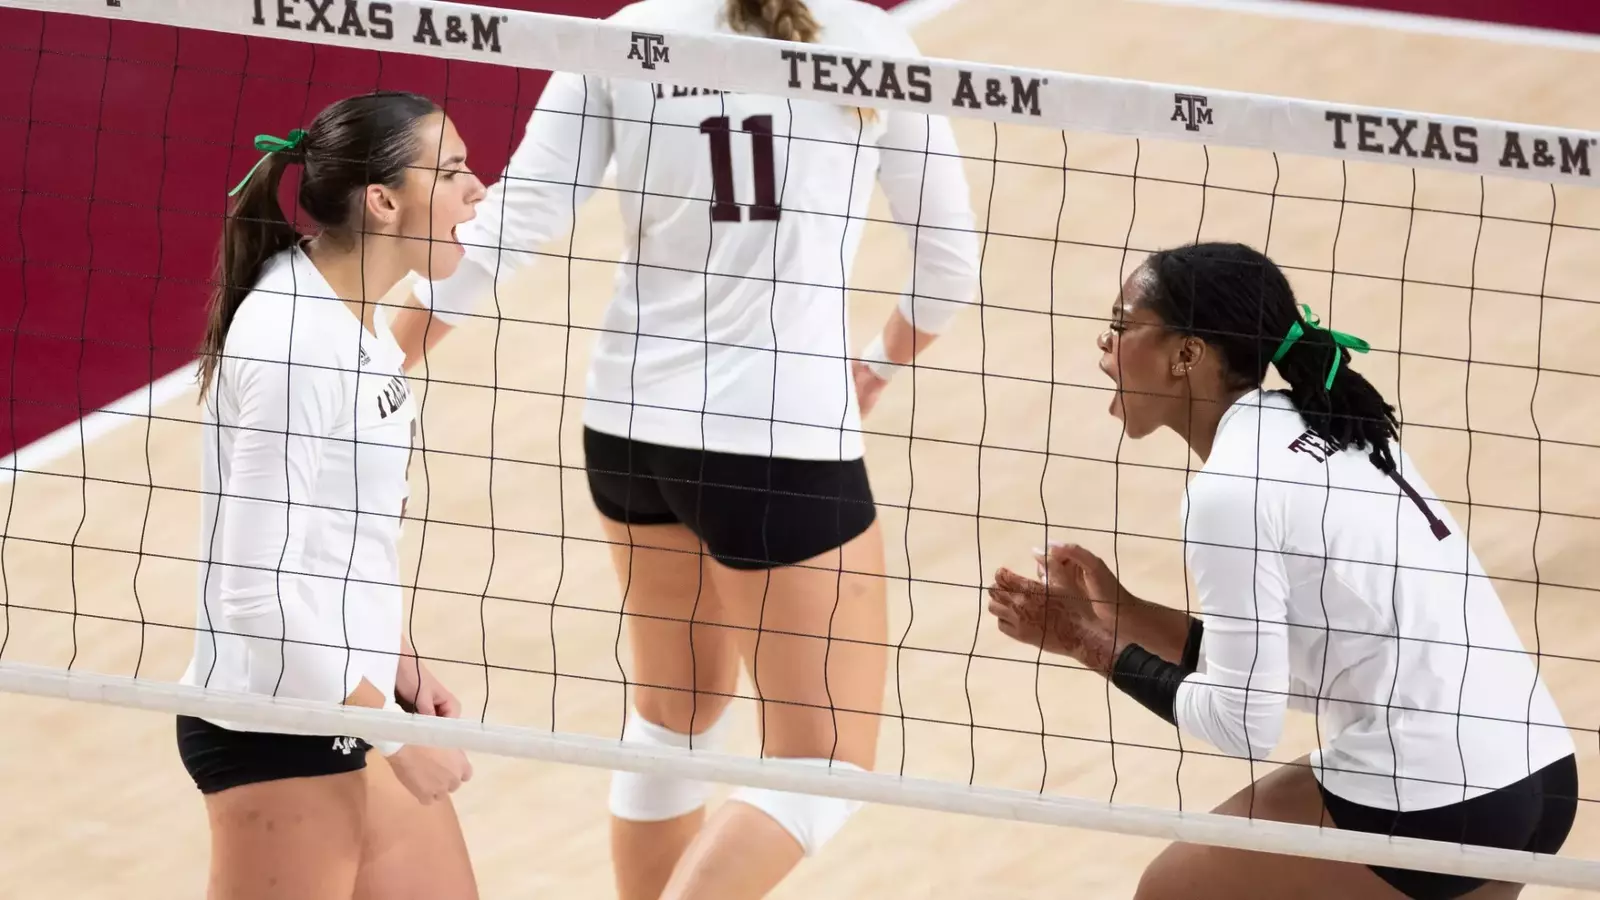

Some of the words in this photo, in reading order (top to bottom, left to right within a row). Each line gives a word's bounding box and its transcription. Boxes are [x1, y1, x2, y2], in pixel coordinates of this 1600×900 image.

[251, 0, 395, 41] TEXAS
[412, 7, 502, 53] A&M
[781, 49, 932, 104] TEXAS
[952, 70, 1042, 116] A&M
[699, 113, 781, 223] 11
[1325, 110, 1479, 164] TEXAS
[1498, 130, 1592, 177] A&M
